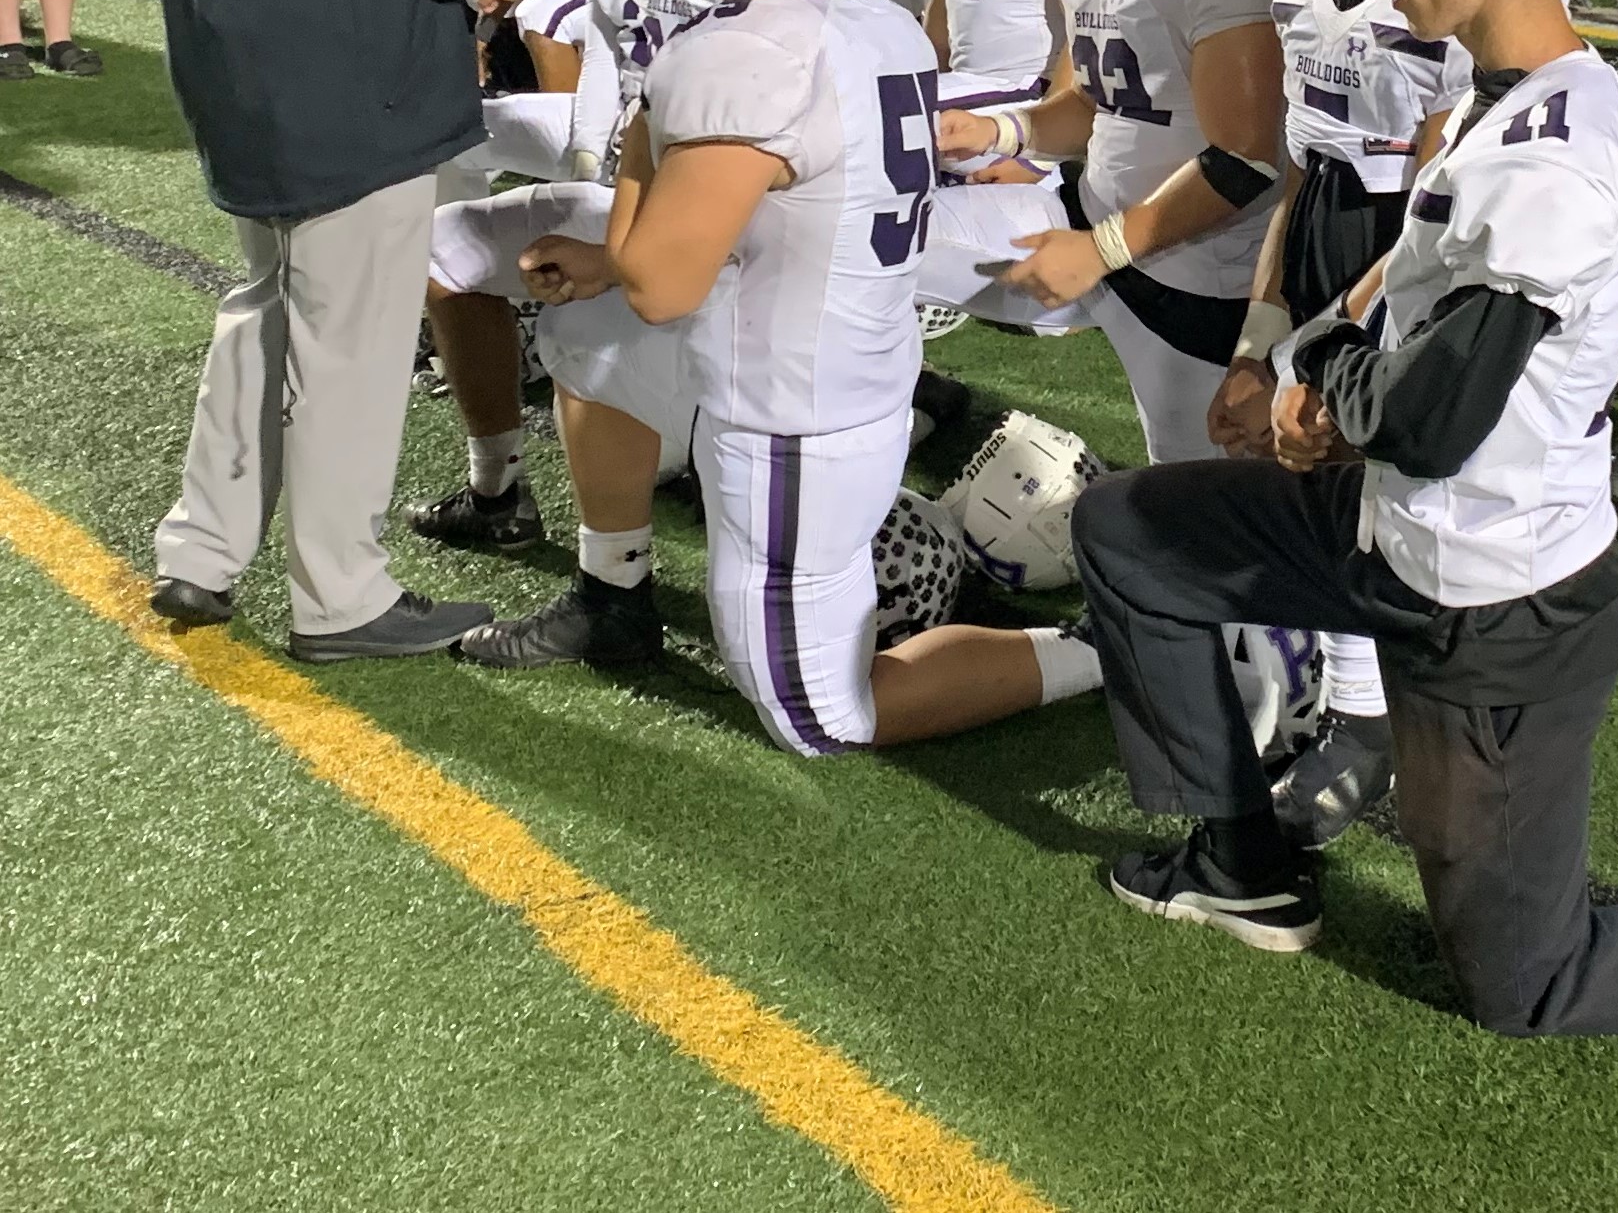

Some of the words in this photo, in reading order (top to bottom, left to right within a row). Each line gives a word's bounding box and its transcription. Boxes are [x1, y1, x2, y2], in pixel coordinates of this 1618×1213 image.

[1295, 54, 1361, 89] BULLDOGS
[1500, 89, 1571, 146] 11
[868, 69, 939, 268] 5
